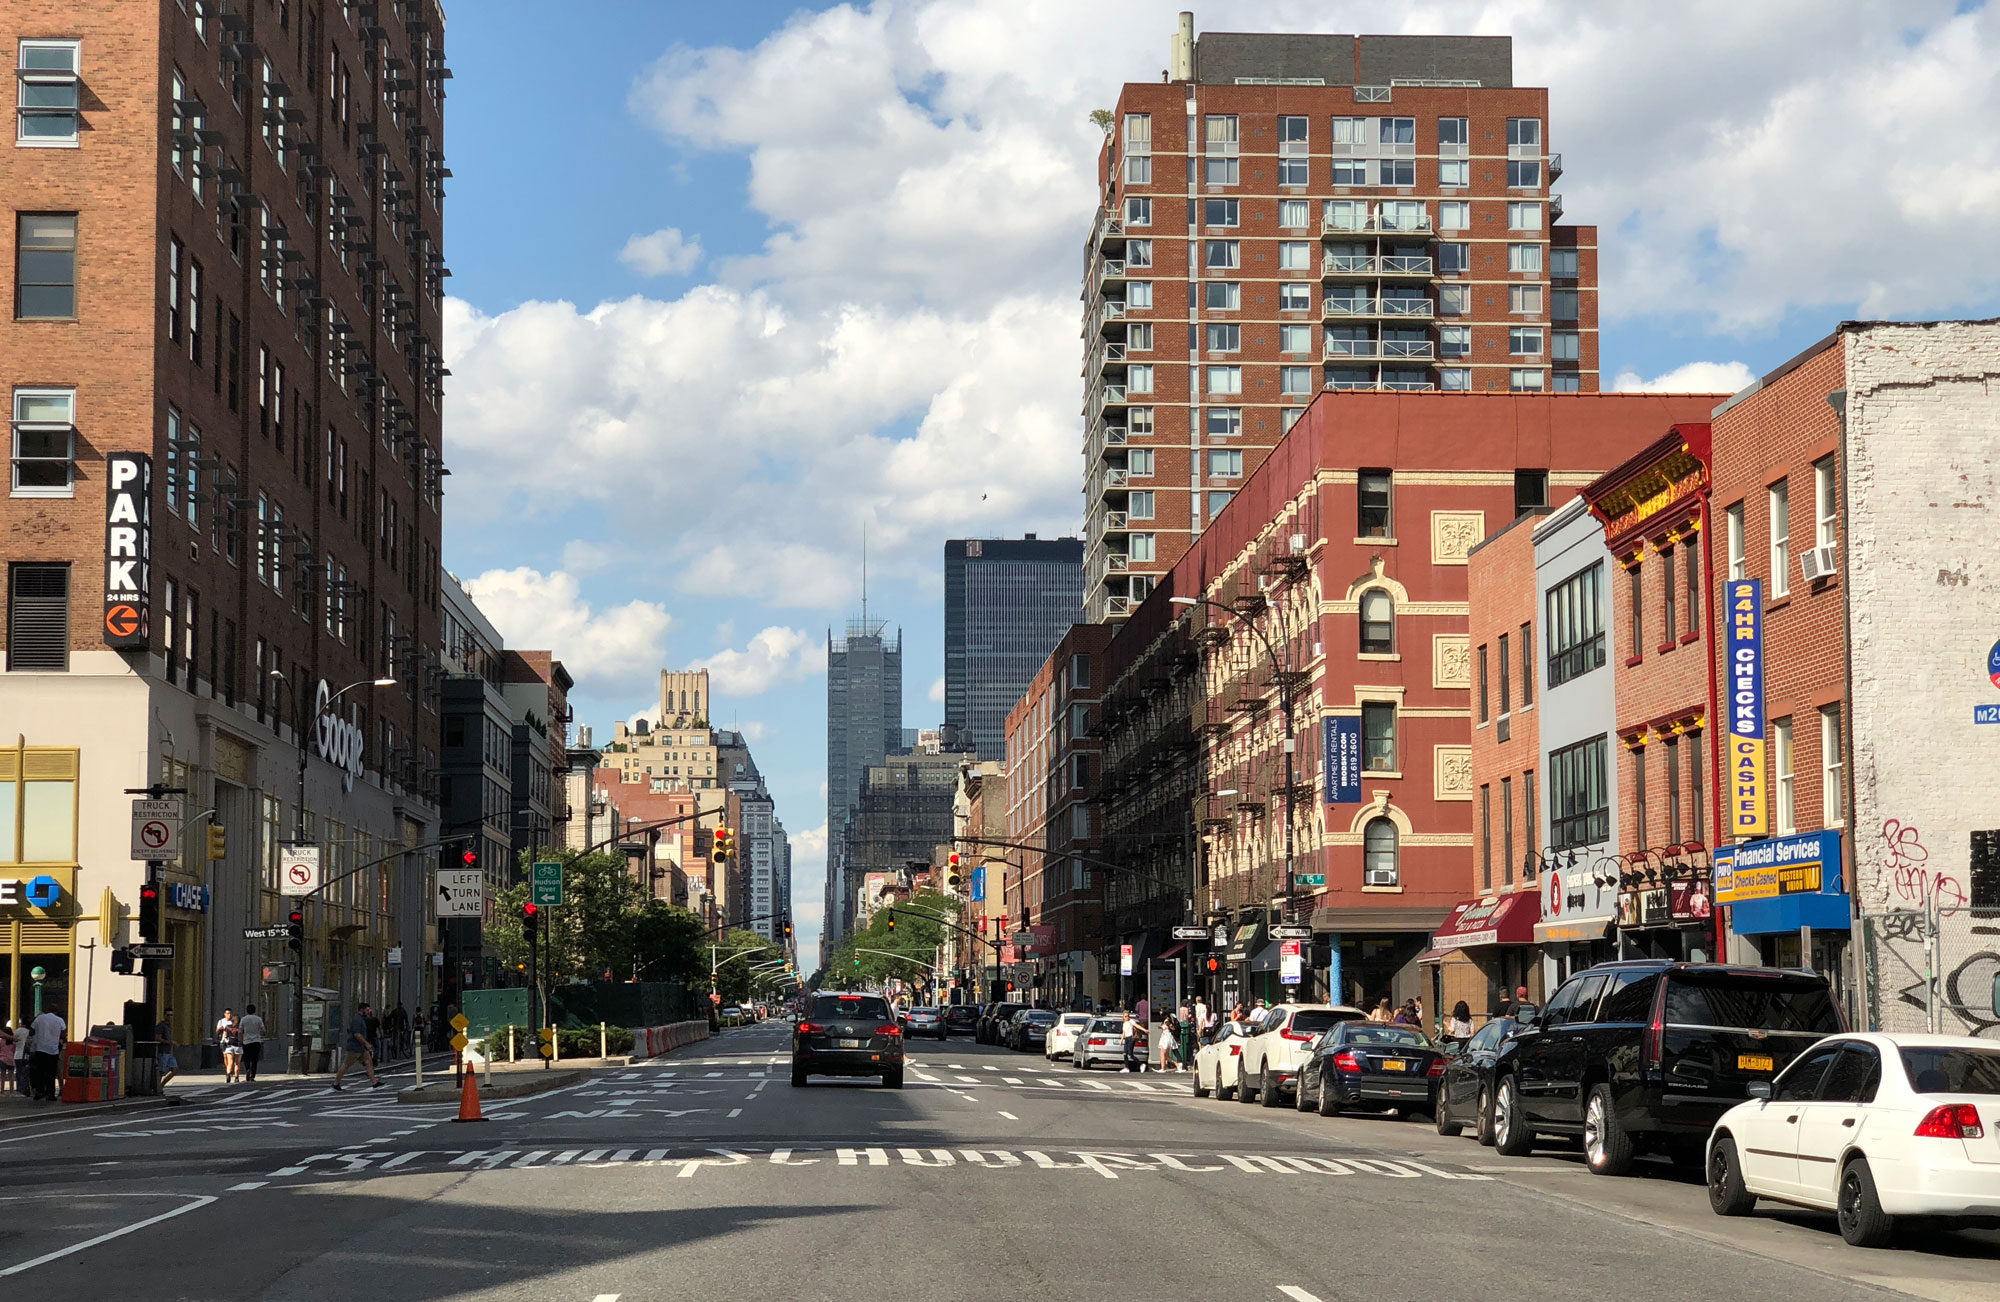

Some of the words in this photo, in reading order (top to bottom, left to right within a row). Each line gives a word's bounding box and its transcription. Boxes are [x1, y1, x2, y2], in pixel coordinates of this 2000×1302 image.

[108, 459, 138, 591] PARK
[142, 462, 150, 594] PARK
[106, 594, 119, 602] 24
[120, 594, 140, 602] HRS
[1735, 648, 1755, 733] CHECKS
[315, 678, 364, 793] Google
[1330, 719, 1338, 753] RENTALS
[1340, 732, 1348, 787] BRODSKY.COM
[1349, 732, 1358, 787] 212.619.2600
[1737, 742, 1757, 826] CASHED
[142, 802, 170, 810] TRUCK
[1734, 843, 1775, 867] Financial
[1776, 838, 1820, 862] Services
[452, 875, 480, 884] LEFT
[1297, 874, 1304, 884] W
[1306, 875, 1315, 884] 15
[1735, 874, 1755, 888] Checks
[1756, 870, 1777, 885] Cashed
[1779, 870, 1803, 882] WESTERN
[1786, 879, 1804, 892] UNION
[176, 882, 202, 910] CHASE
[452, 888, 480, 898] TURN
[451, 902, 480, 911] LANE
[244, 930, 266, 938] West
[267, 929, 281, 937] 15th
[280, 928, 290, 936] St
